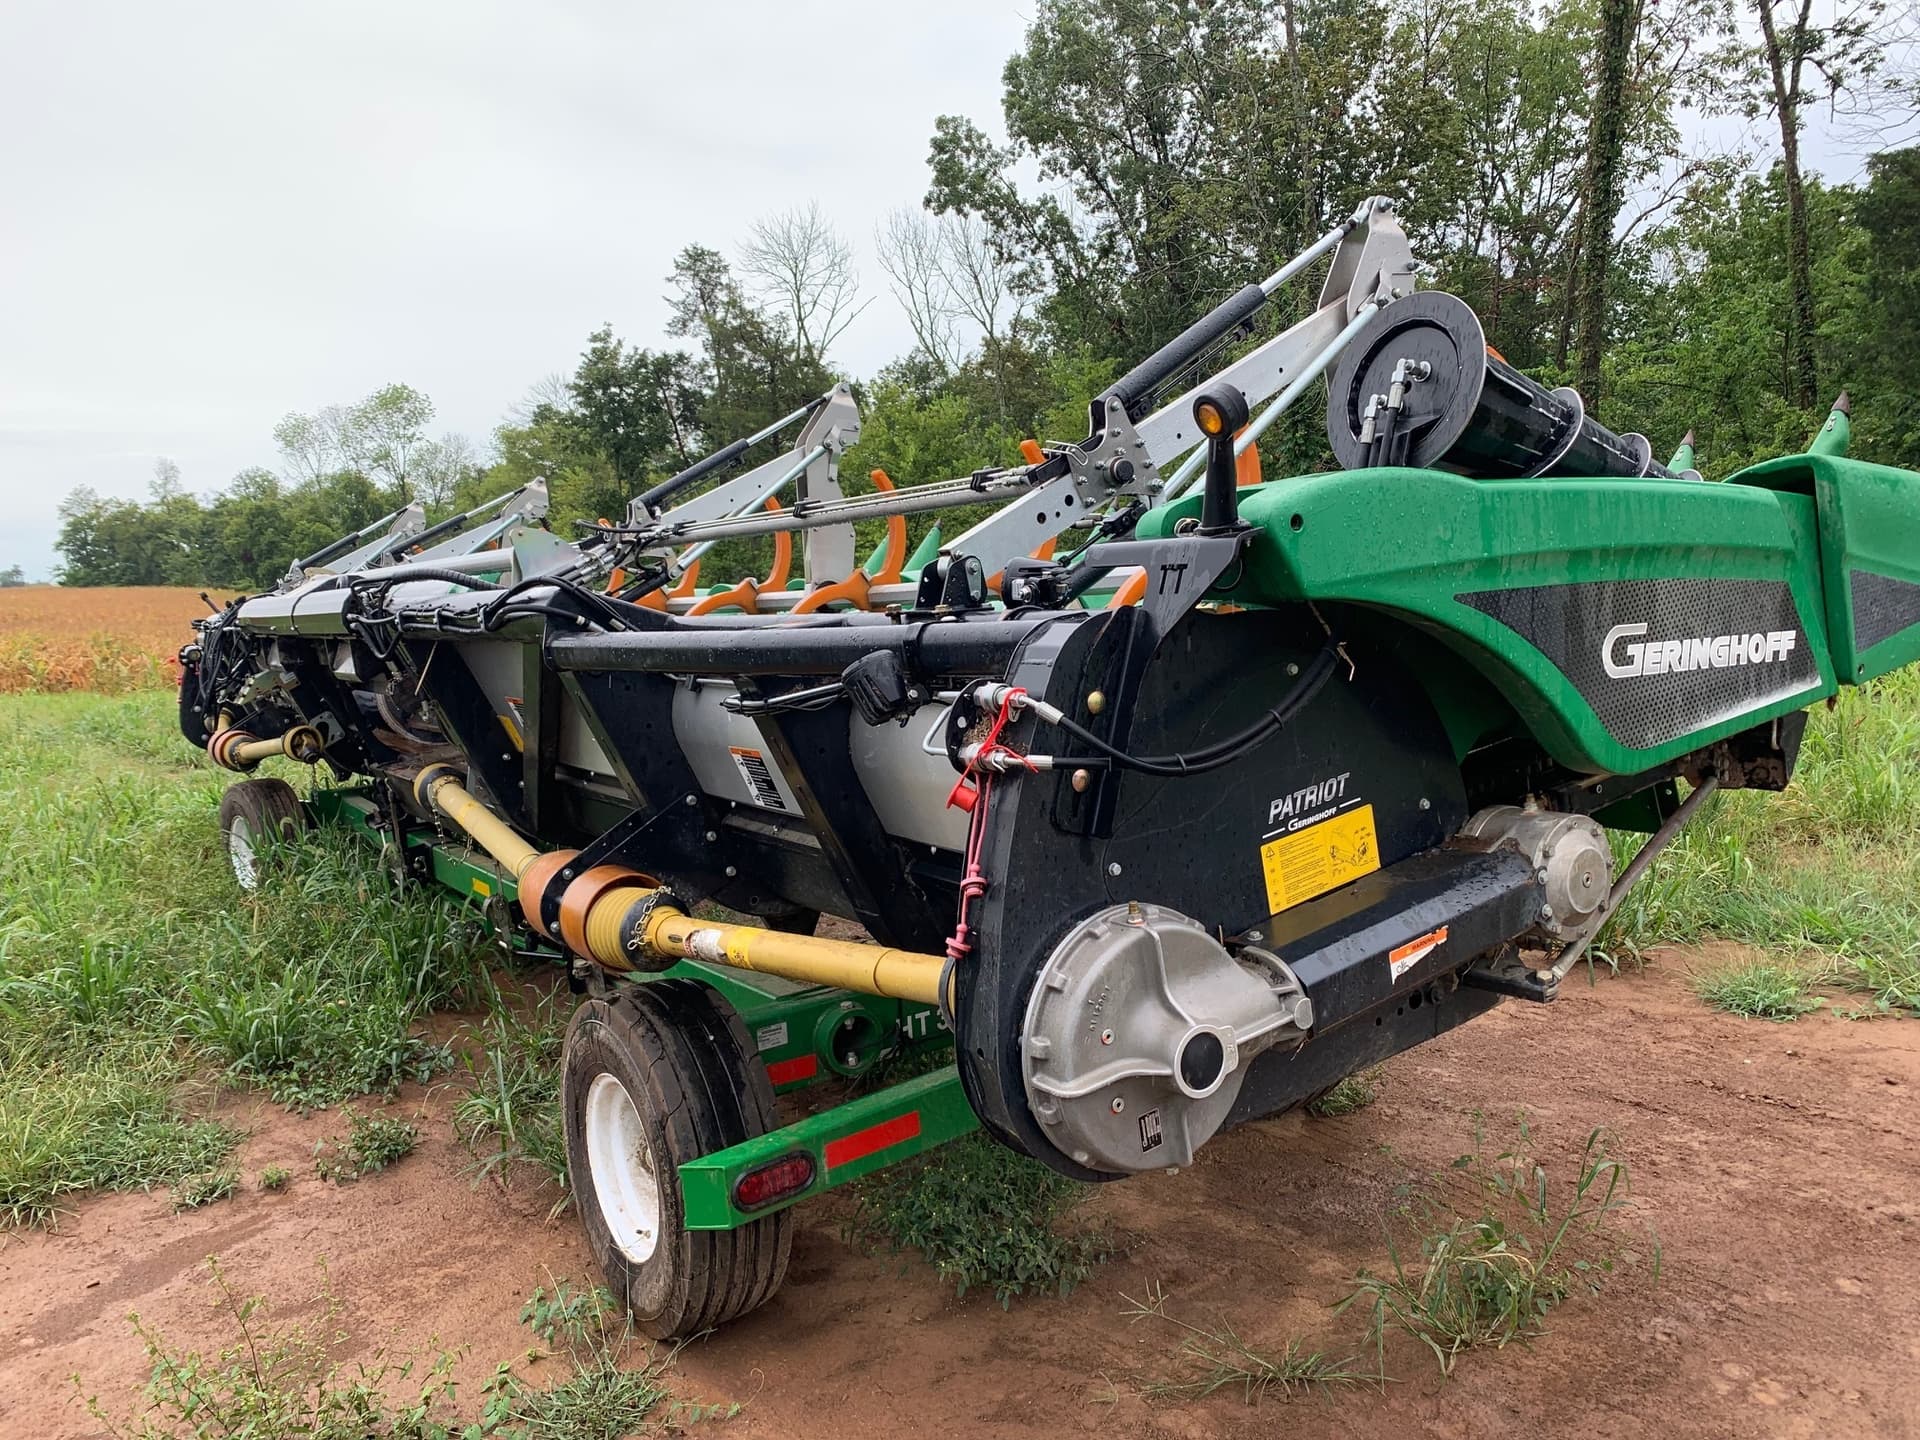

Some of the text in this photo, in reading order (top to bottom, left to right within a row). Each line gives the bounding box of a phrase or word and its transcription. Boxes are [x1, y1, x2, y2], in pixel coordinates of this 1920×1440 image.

[1602, 622, 1797, 679] GERINGHOFF
[1269, 772, 1351, 825] PATRIOT
[1288, 807, 1338, 831] GERINGHOFF
